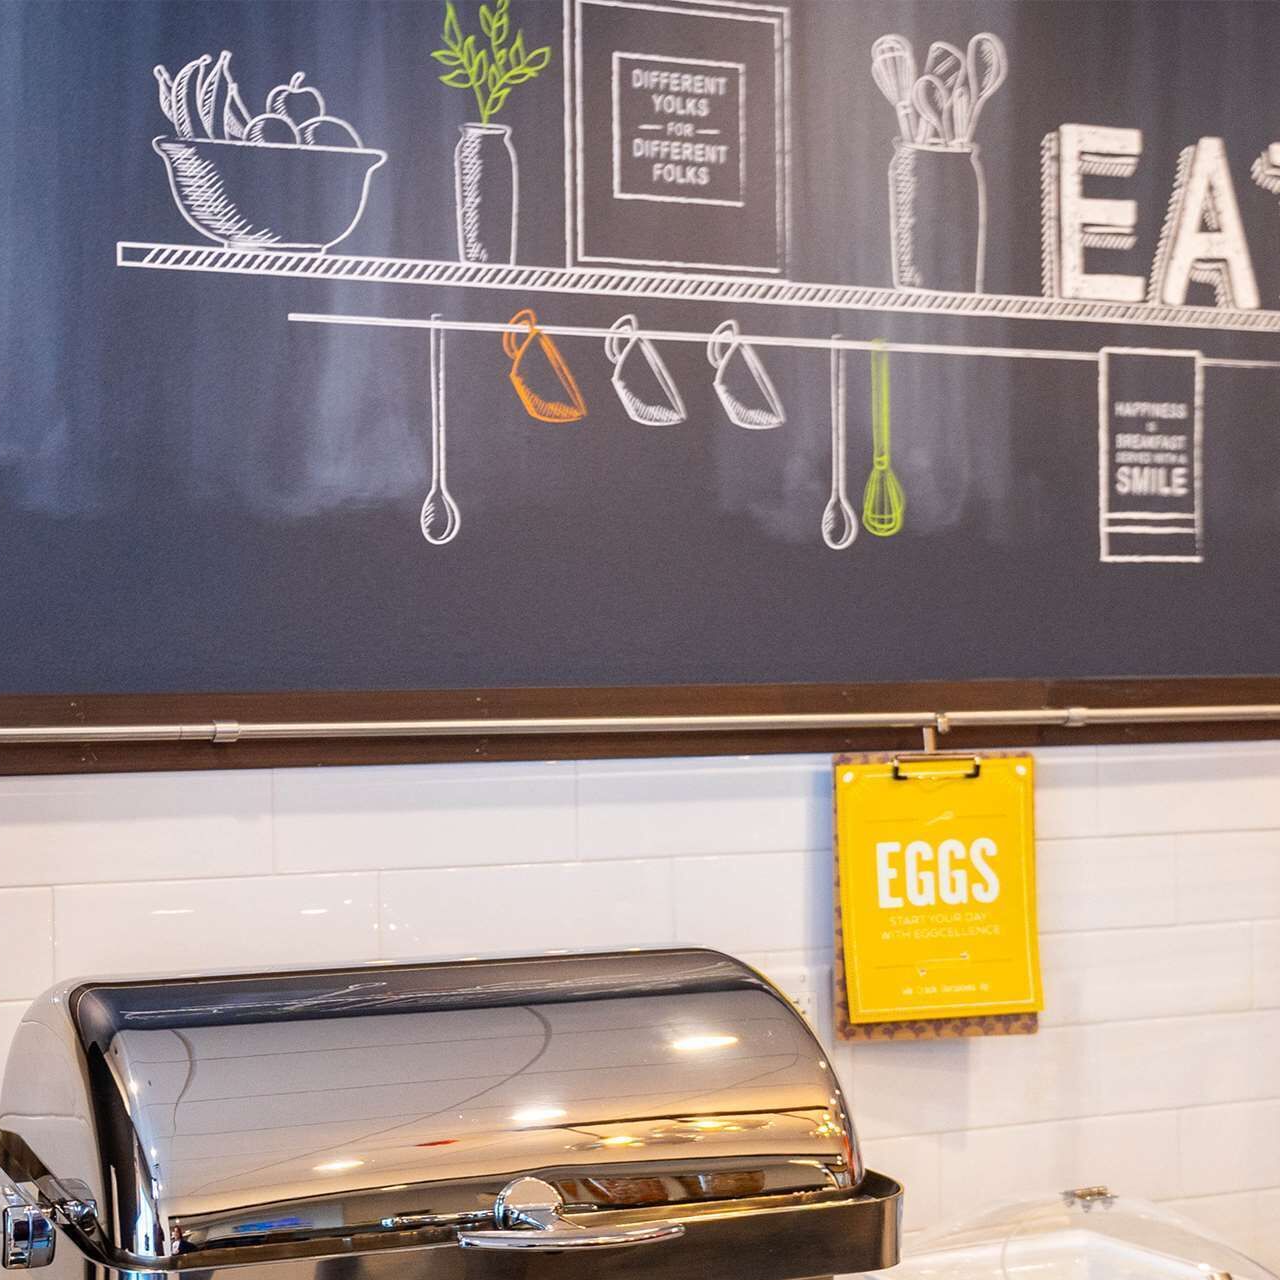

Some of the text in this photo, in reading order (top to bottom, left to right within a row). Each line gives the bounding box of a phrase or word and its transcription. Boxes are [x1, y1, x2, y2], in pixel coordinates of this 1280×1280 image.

[631, 68, 728, 96] DIFFERENT
[651, 94, 710, 117] YOLKS
[666, 121, 695, 137] FOR
[632, 138, 729, 164] DIFFERENT
[652, 163, 710, 185] FOLKS
[1114, 401, 1189, 419] HAPPINESS
[1115, 433, 1187, 450] BREAKFAST
[1115, 466, 1189, 497] SMILE
[876, 837, 1000, 908] EGGS
[888, 911, 988, 926] START YOUR DAY
[880, 929, 911, 941] WITH
